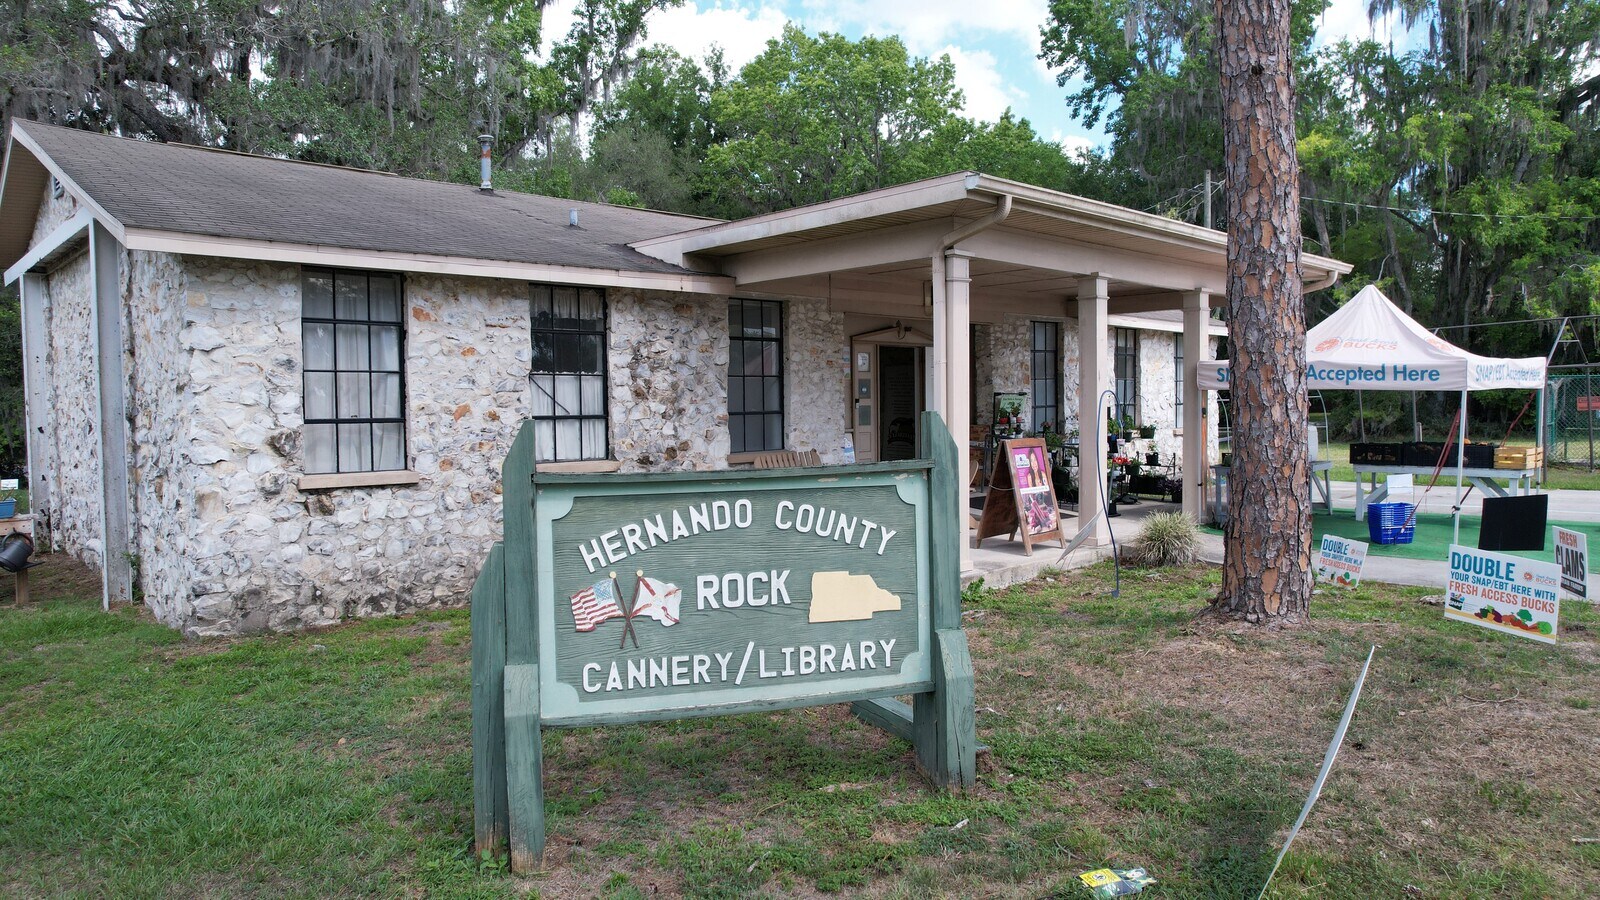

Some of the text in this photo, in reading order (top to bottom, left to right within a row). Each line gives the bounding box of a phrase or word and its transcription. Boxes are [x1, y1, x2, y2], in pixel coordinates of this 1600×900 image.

[1343, 341, 1397, 350] BUCKS
[1306, 363, 1440, 386] Accepted Here
[578, 498, 898, 574] HERNANDO COUNTY
[1323, 539, 1349, 555] DOUBLE
[1559, 531, 1577, 548] FRESH
[1452, 552, 1515, 581] DOUBLE
[1556, 545, 1584, 581] CLAMS
[696, 569, 792, 610] ROCK
[1449, 580, 1555, 614] FRESH ACCESS BUCKS
[1450, 570, 1555, 601] YOUR SNAP/EBT HERE WITH
[582, 638, 897, 694] CANNERY/LIBRARY
